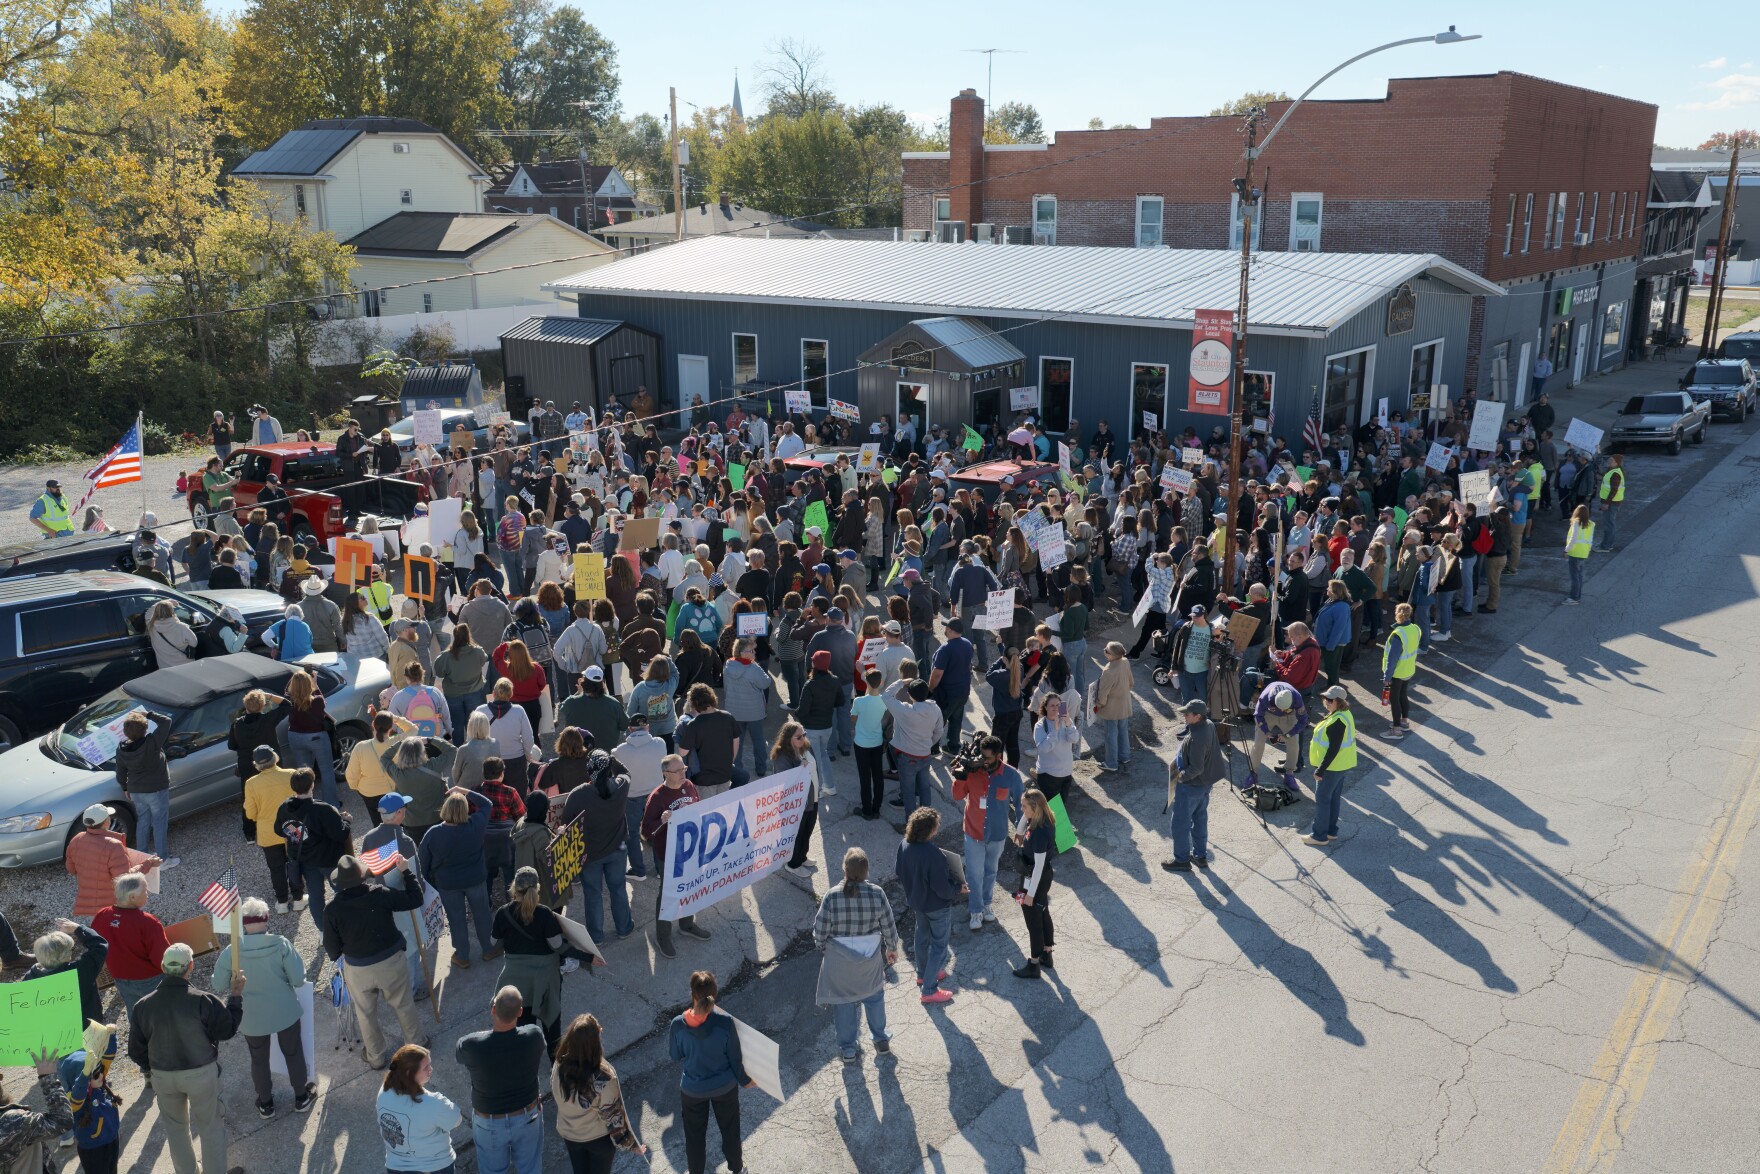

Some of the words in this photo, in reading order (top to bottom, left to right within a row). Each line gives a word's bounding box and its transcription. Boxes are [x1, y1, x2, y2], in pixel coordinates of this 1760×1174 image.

[1572, 290, 1582, 306] H&R
[1582, 287, 1599, 303] BLOCK
[1220, 319, 1232, 327] Stay
[1220, 325, 1232, 333] Pray
[1391, 310, 1414, 323] CALDERA
[1192, 358, 1229, 369] Staunton
[1159, 479, 1188, 493] KIDNAPPING
[584, 554, 595, 566] I
[575, 566, 600, 580] Stand
[755, 781, 804, 810] PROGRESSIVE
[756, 797, 803, 826] DEMOCRATS
[753, 829, 764, 840] OF
[766, 813, 800, 834] AMERICA
[552, 831, 569, 861] THIS
[571, 822, 580, 843] IS
[673, 800, 751, 879] PDA
[553, 833, 586, 880] ISMAELS
[557, 857, 583, 896] HOME
[676, 873, 707, 894] STAND
[722, 857, 744, 873] TAKE
[9, 990, 74, 1015] Felonies
